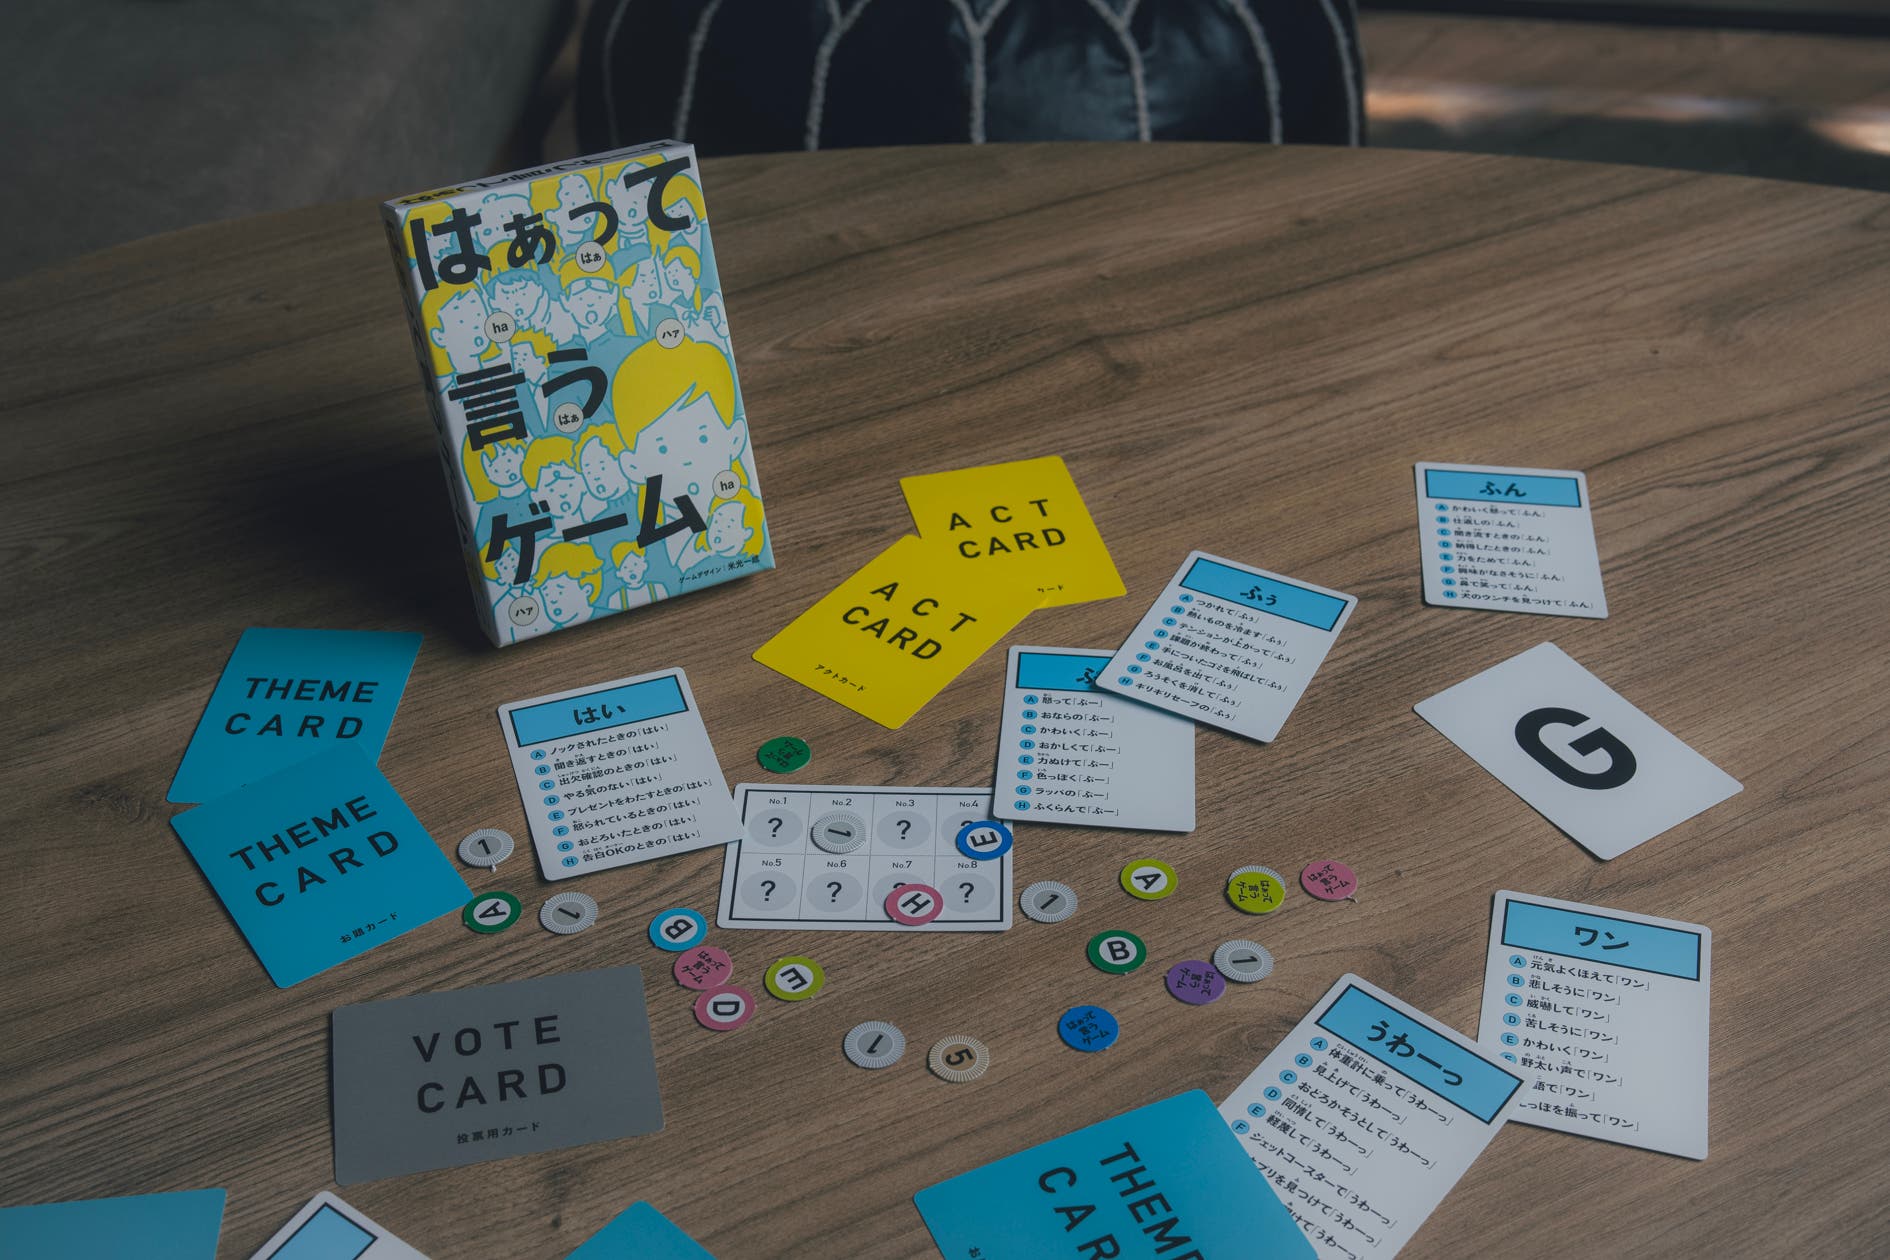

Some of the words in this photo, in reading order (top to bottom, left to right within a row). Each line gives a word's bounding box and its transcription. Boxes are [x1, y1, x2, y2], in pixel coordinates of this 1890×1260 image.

[410, 156, 691, 291] はぁって
[580, 251, 602, 264] はぁ
[492, 321, 509, 333] ha
[448, 348, 608, 451] 言う
[558, 414, 579, 425] はぁ
[721, 479, 734, 491] ha
[1479, 481, 1527, 497] ふん
[949, 499, 1048, 531] ACT
[485, 474, 707, 585] ゲーム
[958, 528, 1066, 559] CARD
[870, 582, 978, 632] ACT
[1239, 585, 1277, 606] ふぅ
[842, 606, 942, 660] CARD
[246, 677, 379, 703] THEME
[815, 663, 867, 692] アクトカード
[225, 713, 363, 739] CARD
[572, 703, 626, 726] はい
[550, 723, 669, 755] ノックされたときの「はい」
[1515, 707, 1637, 790] G
[553, 741, 659, 771] 聞き返すときの「はい」
[563, 773, 662, 800] やる気のない「はい」
[959, 800, 978, 808] No.4
[229, 795, 378, 872] THEME
[577, 815, 696, 847] おどろいたときの「はい」
[970, 831, 998, 847] E
[477, 839, 491, 855] 1
[255, 831, 399, 907] CARD
[827, 860, 847, 868] No.6
[958, 861, 978, 869] No.8
[1135, 872, 1162, 890] A
[1235, 881, 1248, 902] ゲーム
[1324, 880, 1351, 895] ゲーム
[478, 901, 506, 920] A
[557, 907, 581, 920] 1
[901, 893, 931, 914] H
[1040, 894, 1058, 910] 1
[340, 912, 398, 944] お題カード
[665, 918, 693, 940] B
[1574, 926, 1630, 950] ワン
[1107, 940, 1130, 961] B
[1232, 956, 1258, 964] 1
[780, 967, 809, 991] E
[1513, 956, 1523, 966] A
[1530, 959, 1649, 991] 元気よくほえて「ワン」
[1511, 975, 1521, 985] B
[1528, 979, 1620, 1005] 悲しそうに「ワン」
[713, 1001, 740, 1016] D
[1508, 995, 1518, 1005] C
[1526, 998, 1610, 1023] 威嚇して「ワン」
[413, 1015, 561, 1062] VOTE
[1507, 1014, 1517, 1025] D
[1525, 1017, 1618, 1045] 苦しそうに「ワン」
[867, 1034, 883, 1053] 1
[946, 1048, 974, 1065] 5
[1366, 1019, 1463, 1086] うわーっ
[1505, 1035, 1515, 1044] E
[1522, 1037, 1608, 1063] かわいく「ワン」
[1312, 1038, 1326, 1049] A
[1328, 1047, 1454, 1126] 体重計に乗って「うわーっ」
[1520, 1056, 1622, 1086] 野太い声で「ワン」
[417, 1063, 566, 1114] CARD
[1297, 1055, 1310, 1066] B
[1312, 1064, 1407, 1125] 見上げて「うわーっ」
[1532, 1080, 1595, 1101] 語で「ワン」
[456, 1122, 540, 1144] 投票用カード
[1266, 1088, 1280, 1099] D
[1280, 1097, 1373, 1158] 同情して「うわーっ」
[1281, 1071, 1295, 1082] C
[1297, 1081, 1435, 1170] おどろかそうとして「うわーっ」
[1250, 1105, 1263, 1116] E
[1265, 1114, 1357, 1176] 軽蔑して「うわーっ」
[1234, 1122, 1247, 1133] F
[1248, 1132, 1397, 1228] ジェットコースターで「うわーっ」
